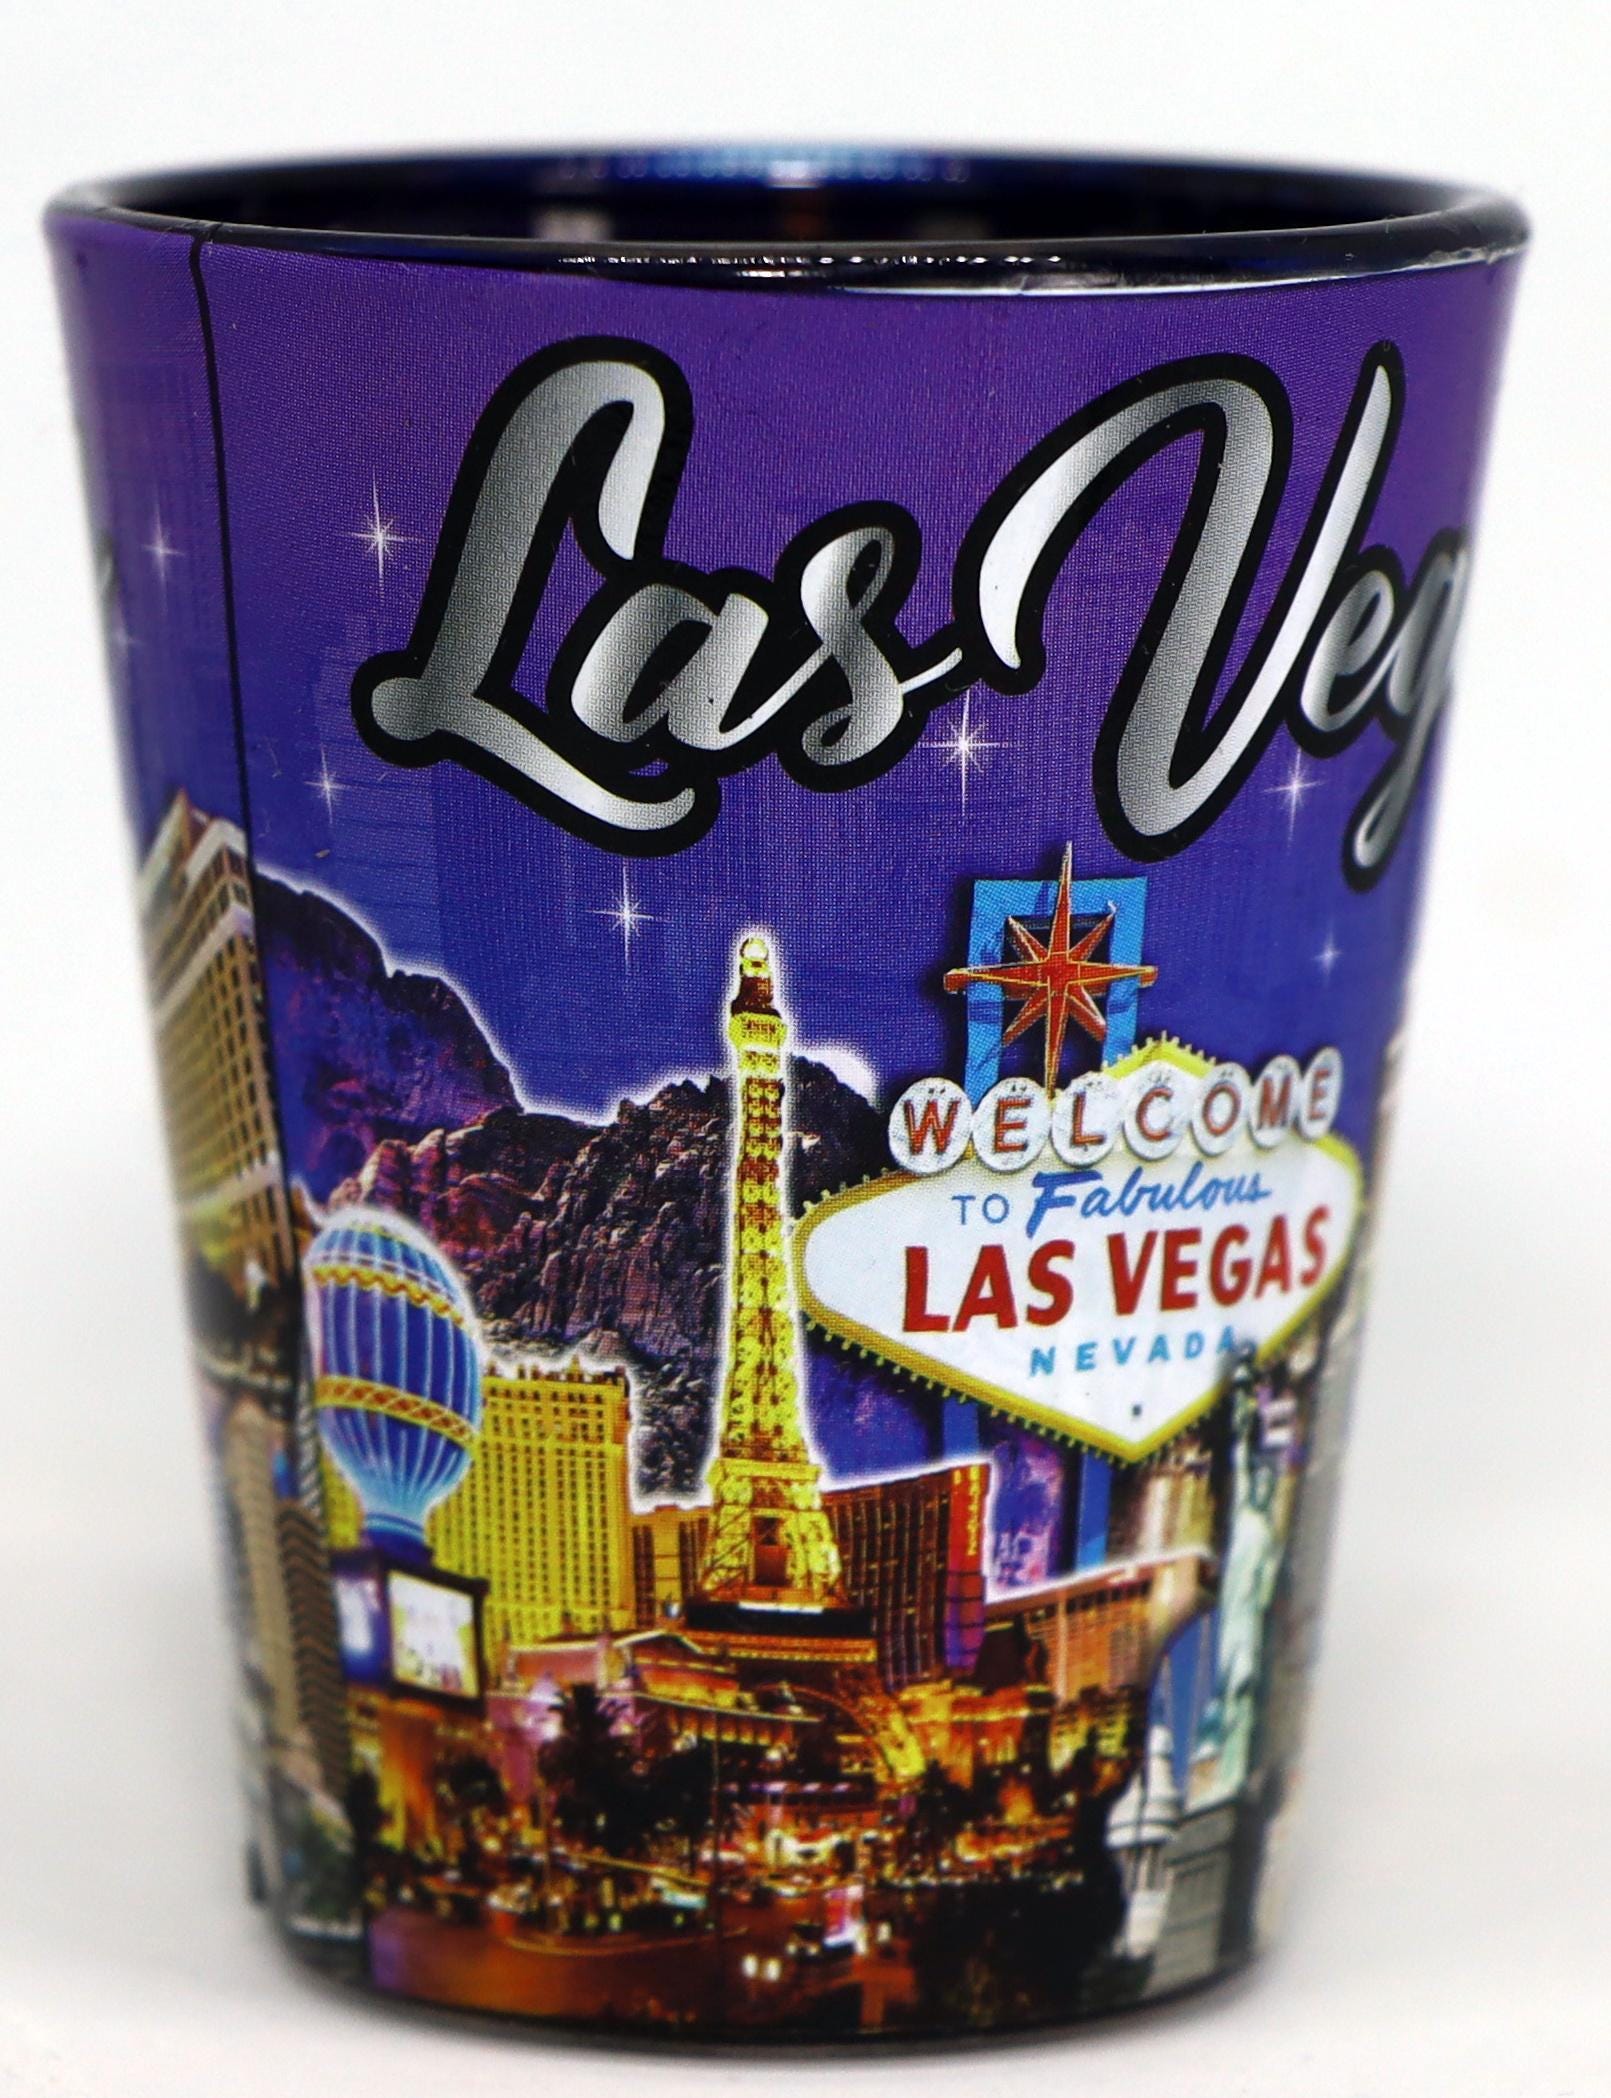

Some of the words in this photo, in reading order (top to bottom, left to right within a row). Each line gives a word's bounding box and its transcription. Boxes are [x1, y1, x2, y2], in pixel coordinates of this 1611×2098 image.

[360, 345, 966, 846] Las
[902, 1067, 1332, 1157] WELCOME
[951, 1193, 1011, 1226] TO
[1025, 1160, 1272, 1240] Fabulous
[902, 1238, 1077, 1333] LAS
[1106, 1204, 1331, 1316] VEGAS
[1028, 1325, 1236, 1378] NEVADA
